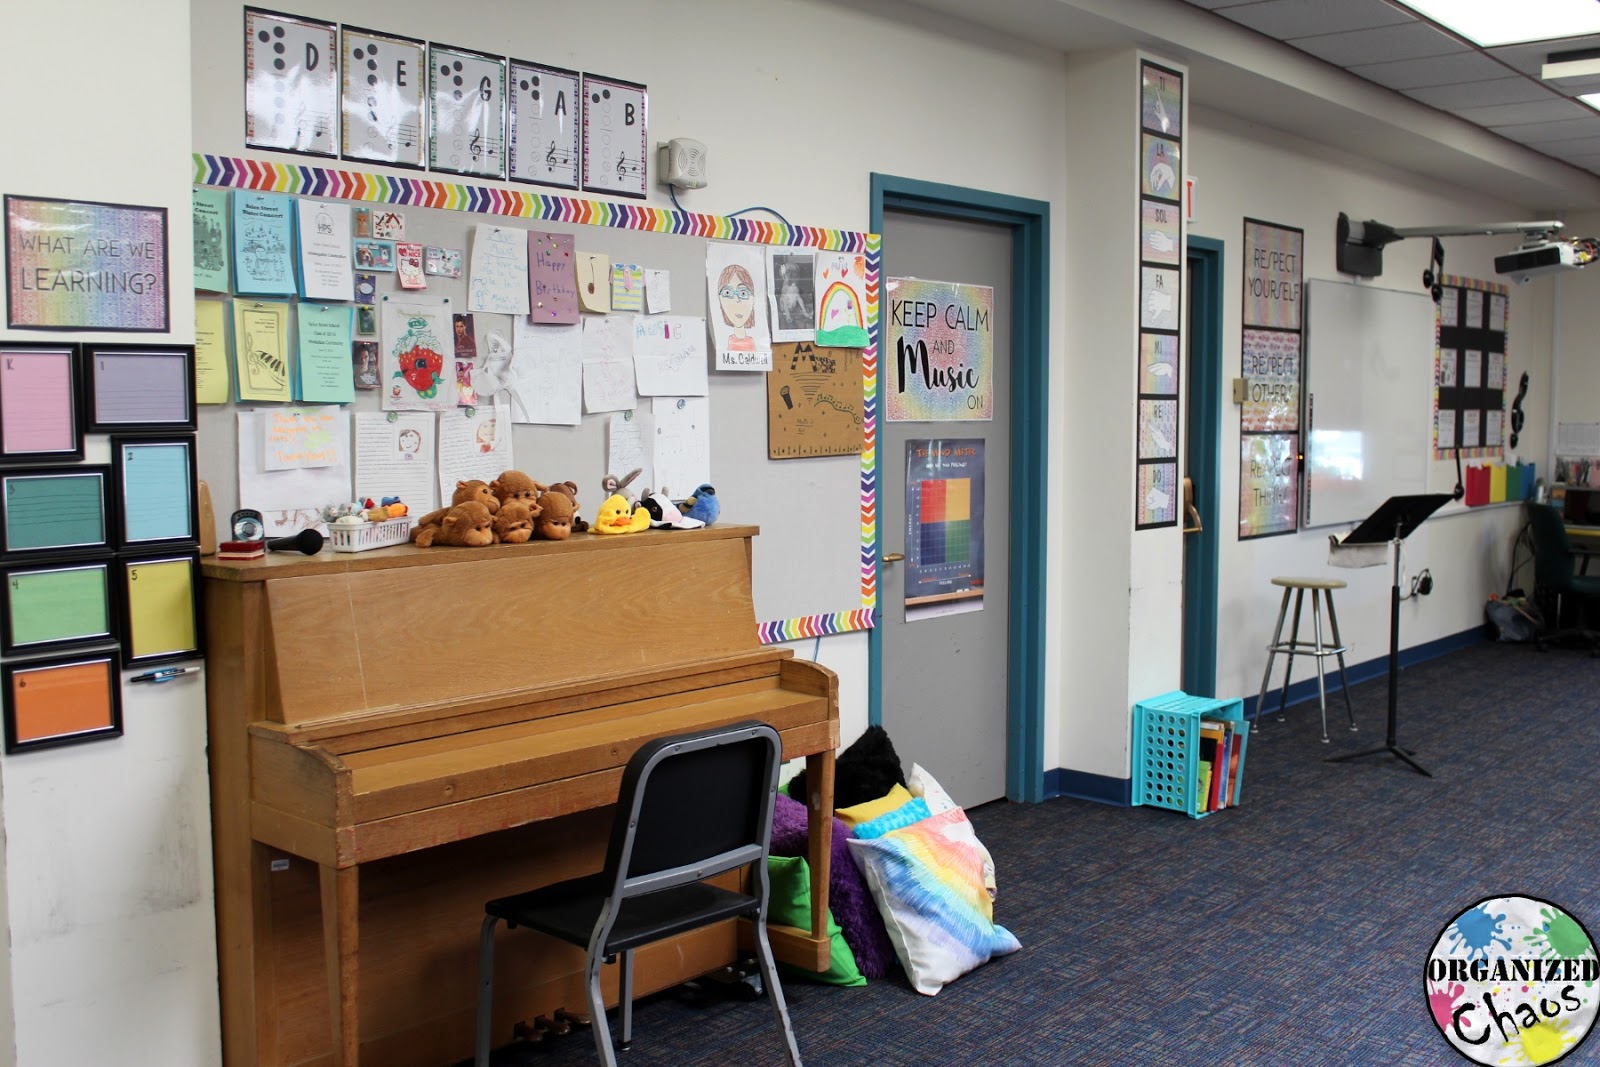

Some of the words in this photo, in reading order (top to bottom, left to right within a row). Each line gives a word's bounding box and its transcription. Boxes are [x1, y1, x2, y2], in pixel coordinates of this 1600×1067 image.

[306, 42, 319, 72] D
[396, 60, 406, 86] E
[479, 76, 492, 102] G
[1159, 76, 1166, 92] TI
[554, 90, 566, 116] A
[625, 102, 635, 126] B
[1156, 143, 1165, 157] LA
[1155, 208, 1168, 224] SOL
[20, 234, 74, 254] WHAT
[84, 239, 120, 258] ARE
[129, 242, 156, 260] WE
[536, 252, 566, 272] Happy
[1254, 248, 1296, 273] RESPECT
[22, 267, 157, 295] LEARNING?
[536, 280, 576, 298] Birthday
[1156, 274, 1164, 288] FA
[1248, 278, 1299, 302] YOURSELF
[892, 299, 937, 328] KEEP
[945, 304, 989, 332] CALM
[932, 340, 955, 354] AND
[1154, 340, 1162, 354] MI
[6, 358, 14, 370] K
[722, 352, 738, 364] Ms.
[896, 336, 980, 394] Music
[1252, 356, 1294, 376] RESPECT
[1252, 384, 1292, 402] OTHERS
[967, 395, 984, 410] ON
[1153, 404, 1162, 419] RE
[128, 452, 133, 460] 2
[1152, 469, 1162, 484] DO
[9, 484, 15, 495] 3
[131, 570, 138, 581] 5
[12, 579, 19, 590] 4
[19, 678, 26, 688] 6
